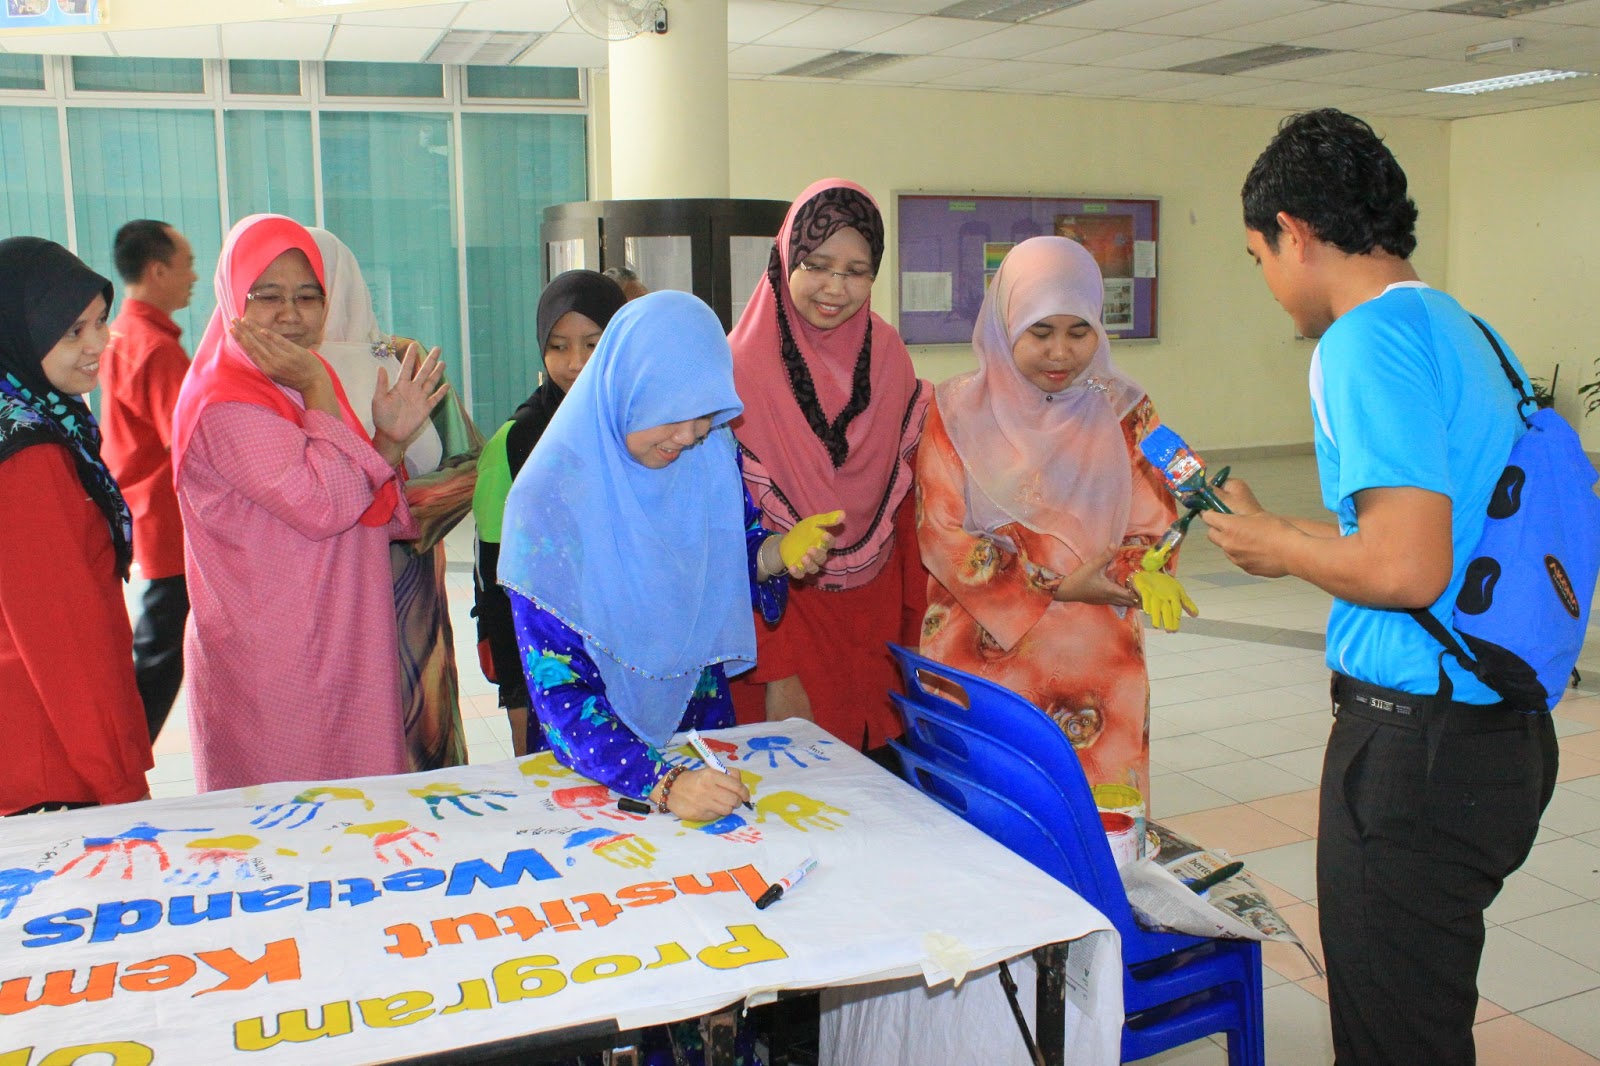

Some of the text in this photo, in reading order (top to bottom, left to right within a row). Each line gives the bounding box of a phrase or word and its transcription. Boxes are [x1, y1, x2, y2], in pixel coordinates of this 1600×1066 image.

[21, 847, 563, 948] Wetlands
[384, 863, 769, 959] Institut
[233, 924, 790, 1052] Program
